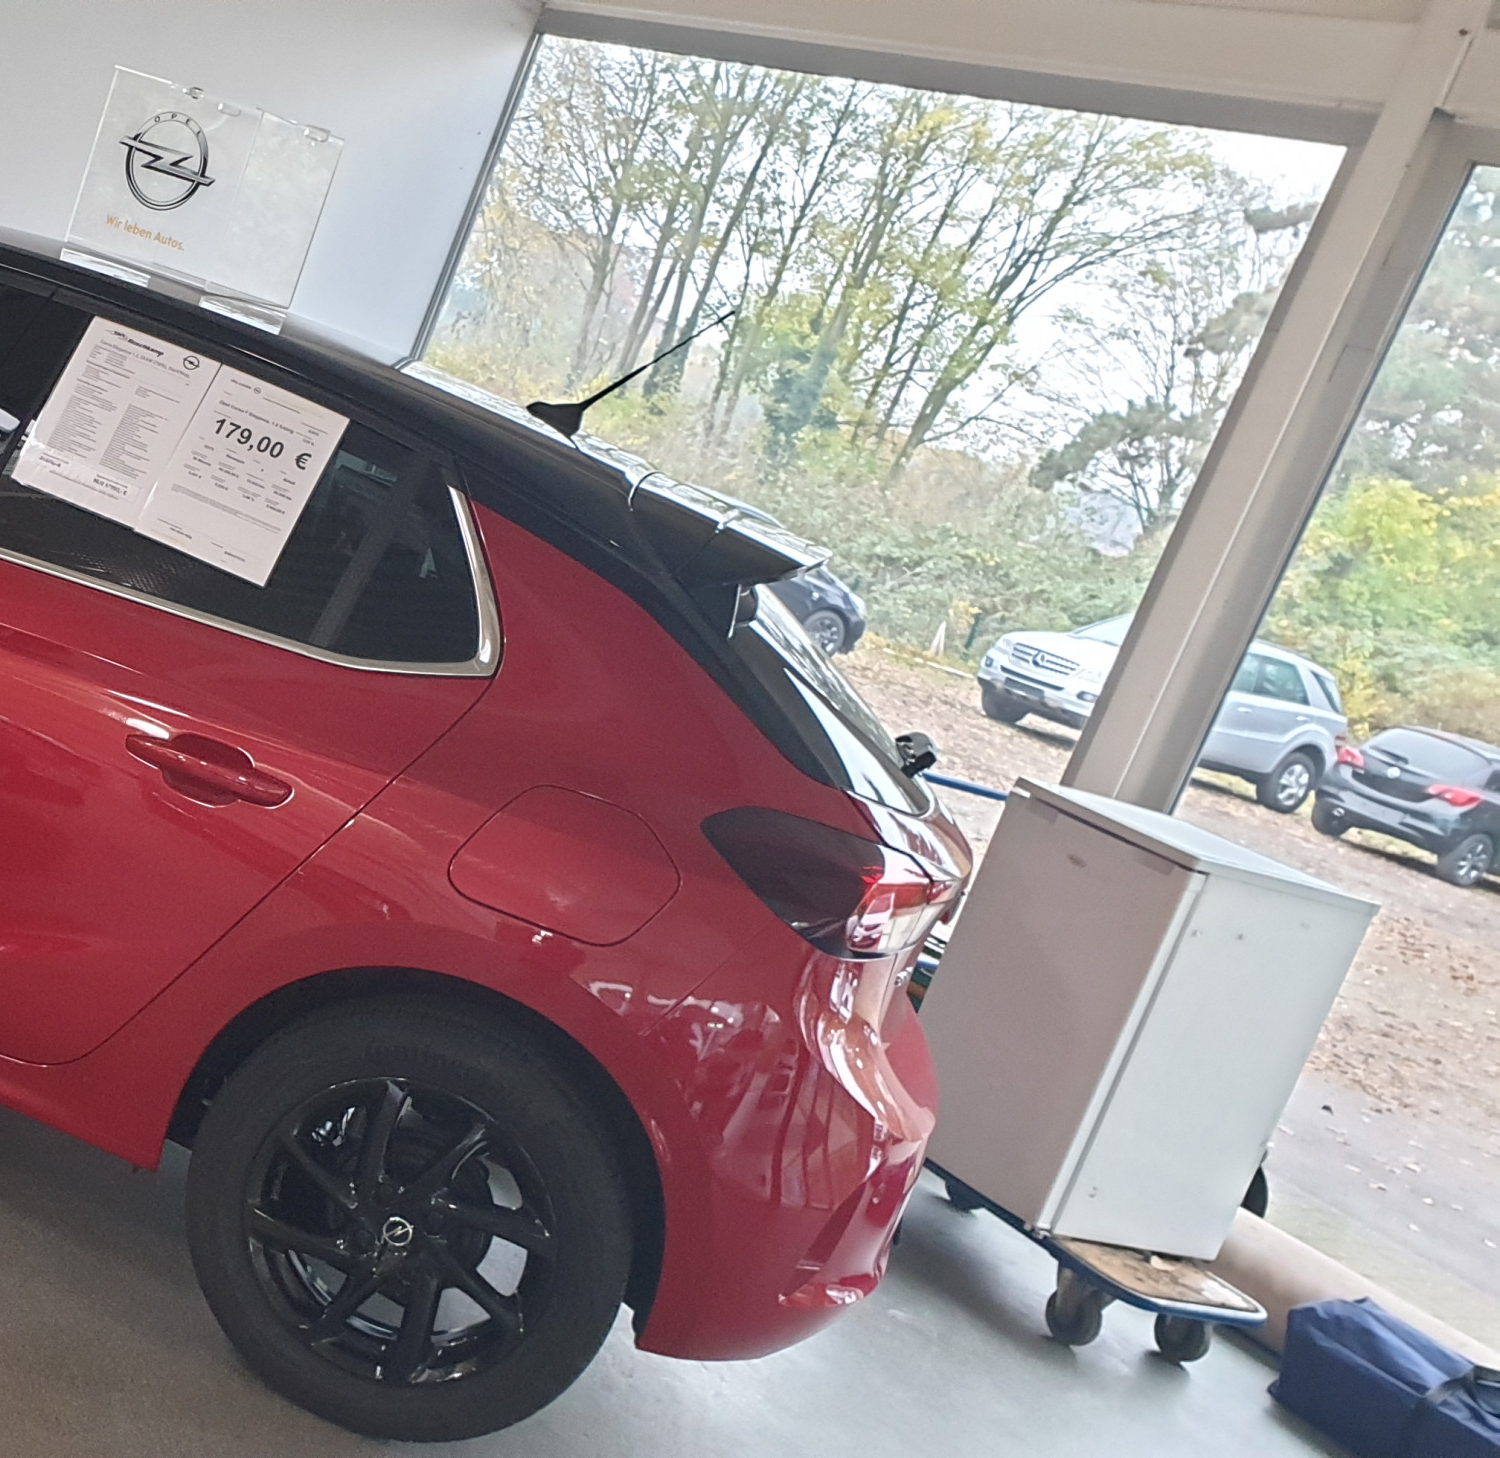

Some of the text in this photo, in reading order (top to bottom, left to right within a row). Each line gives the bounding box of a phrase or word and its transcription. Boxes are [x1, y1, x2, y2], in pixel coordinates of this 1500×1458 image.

[154, 112, 202, 136] OPEL
[106, 214, 185, 251] Wir leben Autos.
[215, 418, 285, 459] 179,00
[295, 452, 312, 470] €
